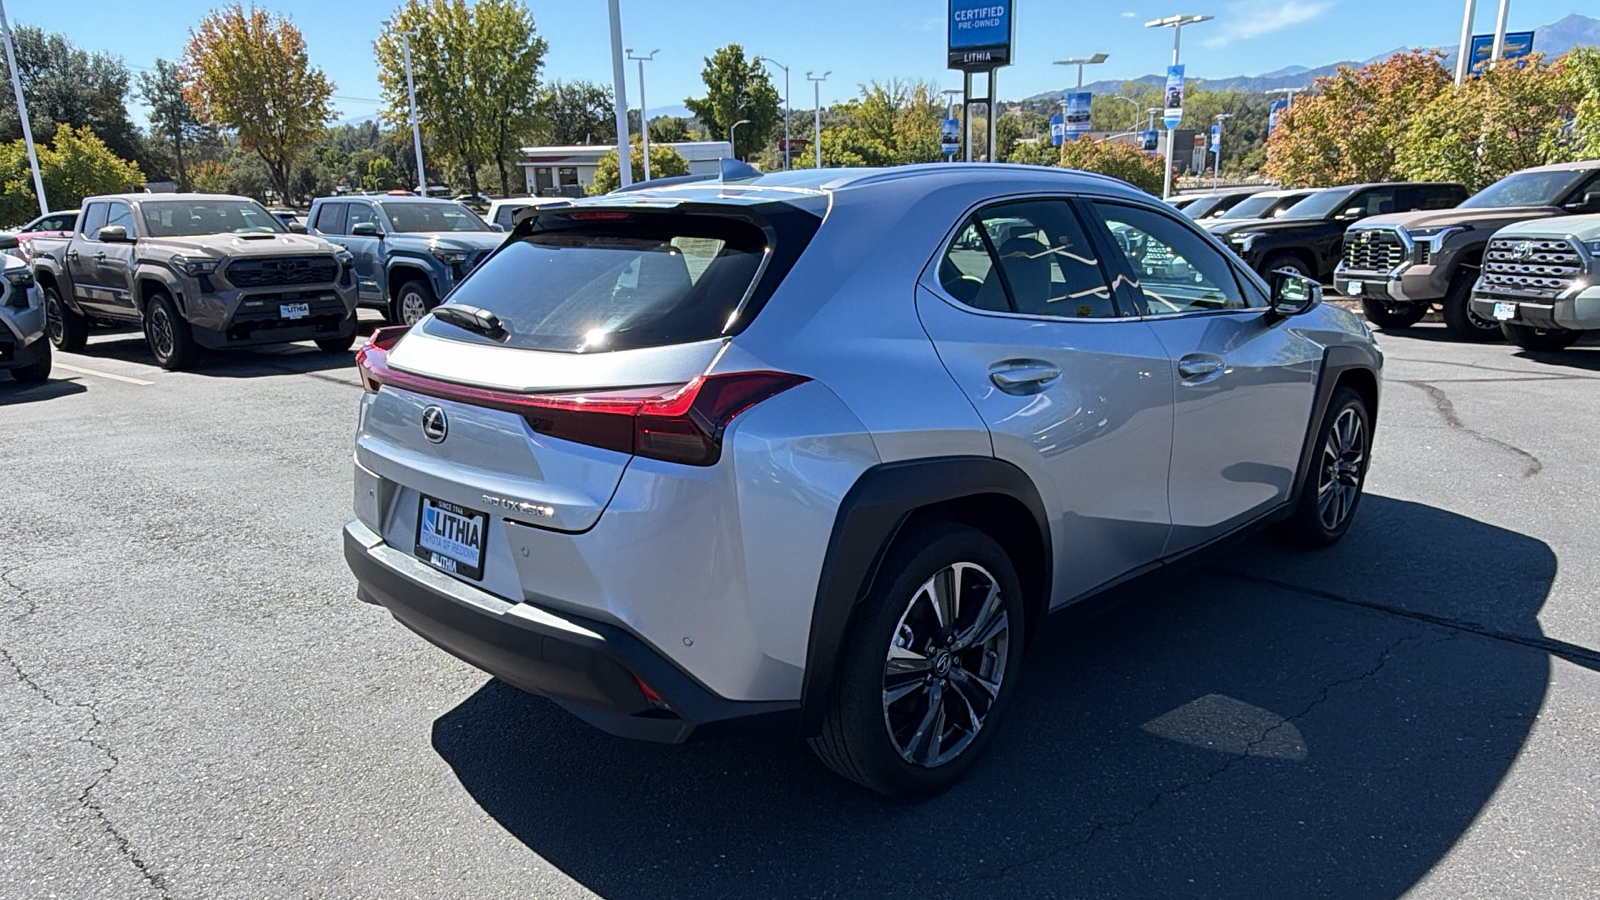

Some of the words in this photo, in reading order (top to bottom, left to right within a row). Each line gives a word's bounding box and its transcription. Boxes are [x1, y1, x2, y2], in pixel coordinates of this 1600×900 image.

[954, 6, 1004, 21] CERTIFIED
[958, 18, 1000, 30] PRE-OWNED
[963, 52, 991, 63] LITHIA
[438, 501, 452, 511] SINCE
[435, 511, 480, 550] LITHIA
[422, 531, 441, 547] TOYOTA
[442, 539, 450, 551] OF
[436, 554, 457, 573] LITHIA
